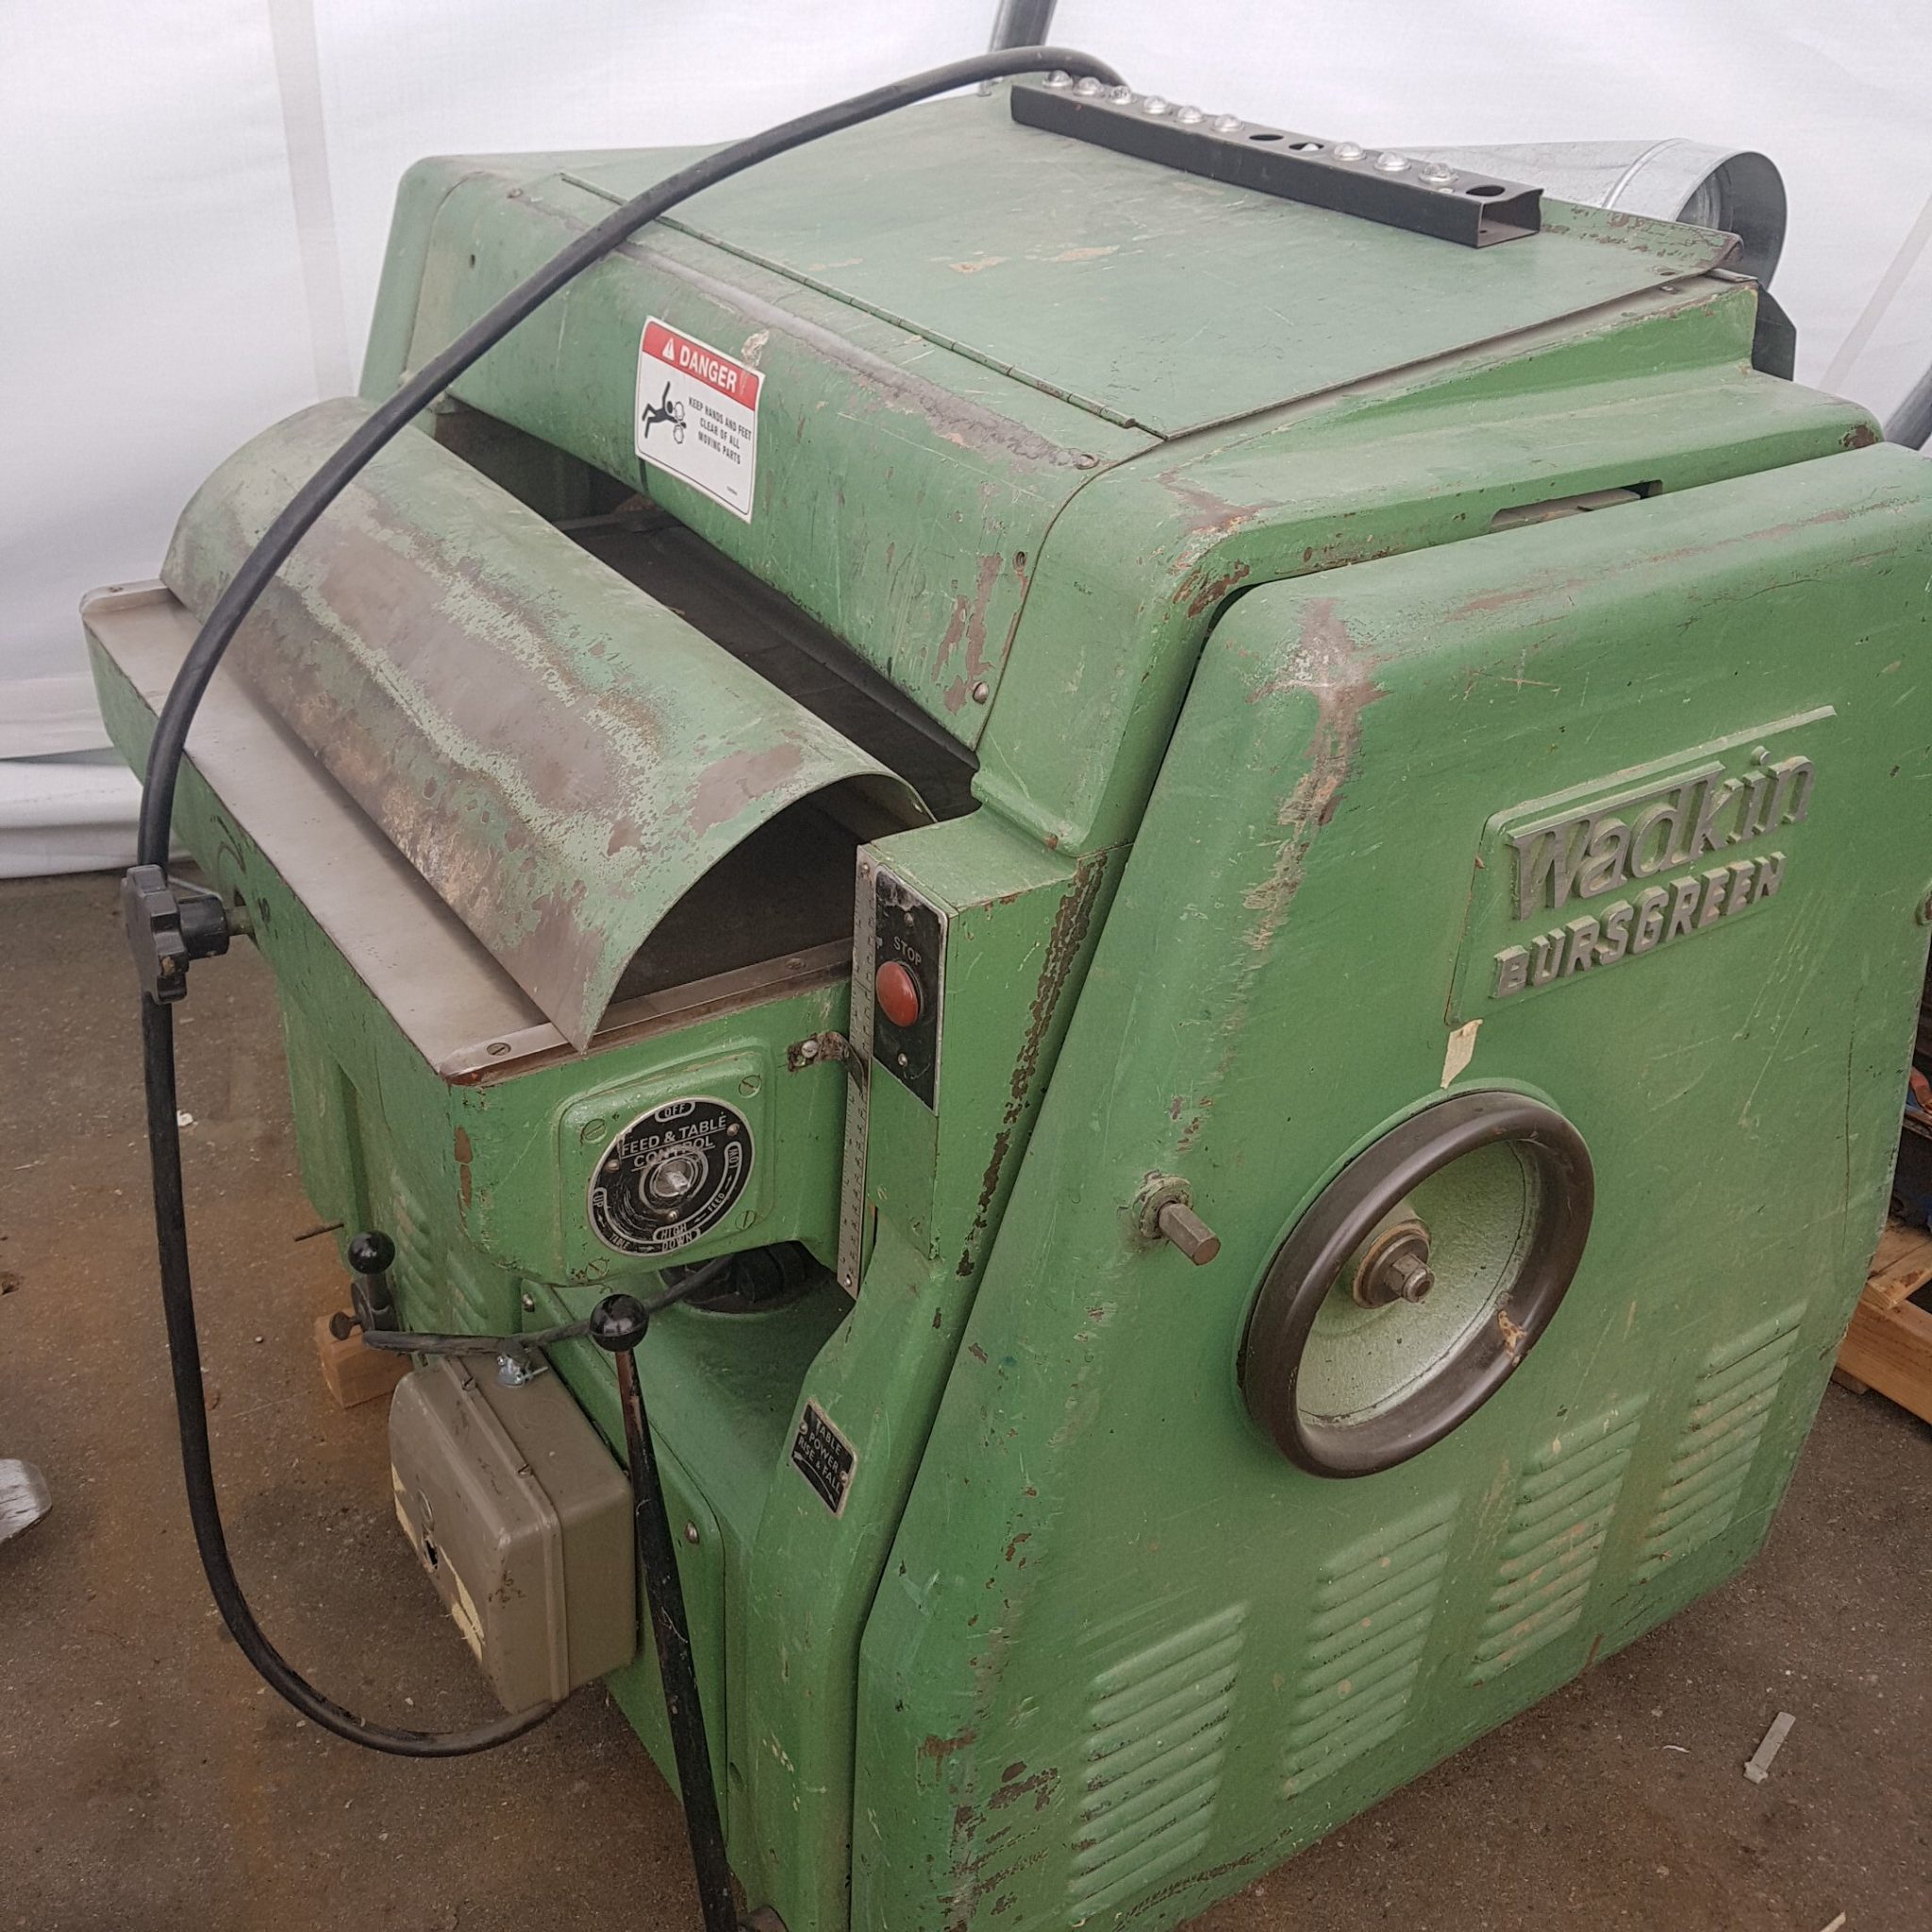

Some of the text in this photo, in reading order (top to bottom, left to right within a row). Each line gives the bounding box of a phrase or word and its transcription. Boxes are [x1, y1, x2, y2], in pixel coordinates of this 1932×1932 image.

[679, 345, 738, 392] DANGER
[689, 397, 752, 440] KEEP HANDS AND FEET
[700, 418, 740, 449] CLEAR OF ALL
[698, 432, 741, 464] MOVING PARTS
[1505, 745, 1816, 921] Wadkin
[1489, 851, 1787, 998] BURSGREEN
[893, 936, 922, 967] STOP
[664, 1104, 686, 1118] OFF
[622, 1115, 727, 1156] FEED & TABLE
[593, 1193, 604, 1207] UP
[708, 1192, 725, 1212] FEED
[609, 1233, 630, 1250] TABLE
[660, 1224, 687, 1239] HIGH
[662, 1232, 692, 1252] DOWN
[808, 1432, 839, 1474] POWER
[817, 1421, 841, 1455] TABLE
[798, 1436, 816, 1461] RISE
[822, 1466, 841, 1495] FALL
